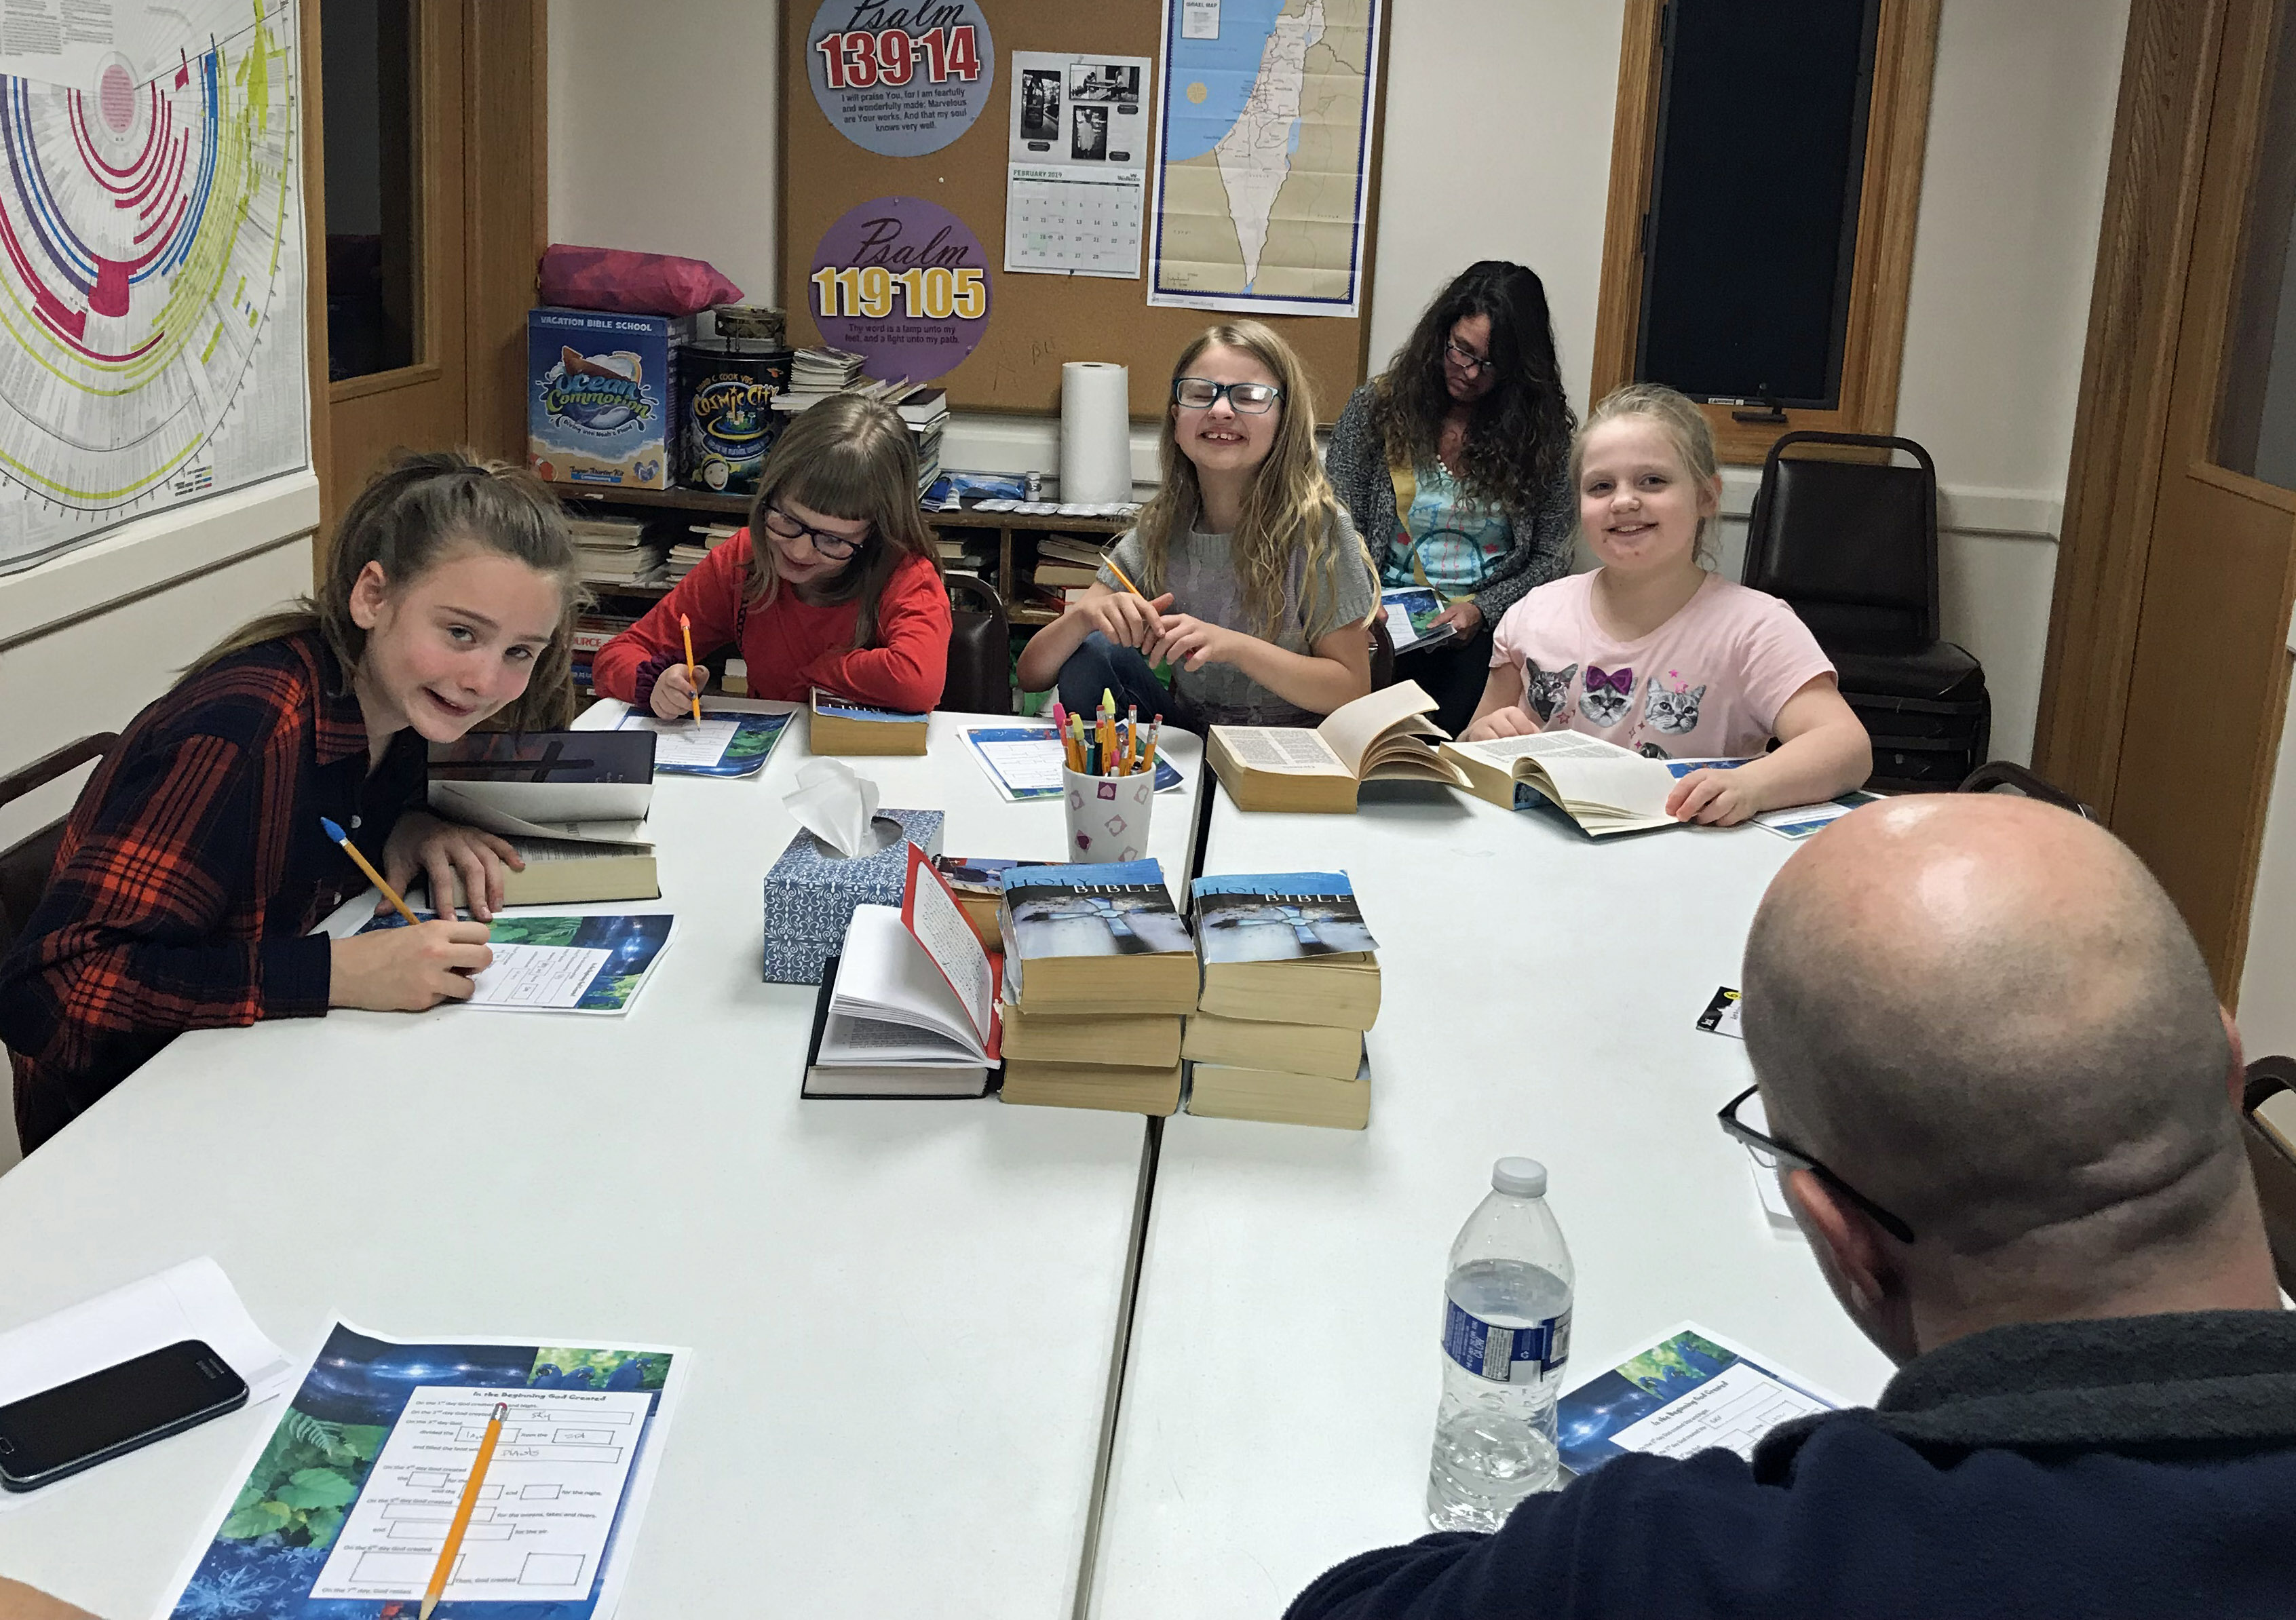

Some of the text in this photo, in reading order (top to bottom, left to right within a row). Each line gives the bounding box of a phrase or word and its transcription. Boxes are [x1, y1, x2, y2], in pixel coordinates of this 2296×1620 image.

[846, 0, 964, 30] Psalm
[816, 25, 980, 89] 139:14
[846, 94, 859, 102] will
[861, 93, 883, 102] praise
[885, 92, 902, 101] You,
[904, 91, 915, 99] for
[934, 88, 965, 98] fearfully
[842, 104, 856, 113] and
[858, 102, 902, 112] wonderfully
[927, 99, 967, 108] Marvelous
[857, 114, 875, 123] Your
[904, 112, 919, 120] And
[921, 111, 936, 119] that
[937, 111, 948, 120] my
[951, 109, 967, 117] soul
[875, 123, 900, 132] knows
[901, 124, 917, 132] very
[1013, 170, 1046, 178] FEBRUARY
[852, 218, 969, 265] Psalm
[811, 266, 986, 319] 119:105
[541, 316, 653, 332] VACATION BIBLE SCHOOL
[849, 324, 864, 334] Thy
[902, 325, 922, 334] lamp
[944, 327, 956, 335] my
[864, 334, 879, 343] and
[887, 334, 905, 345] light
[926, 336, 938, 345] my
[940, 335, 959, 345] path.
[719, 373, 738, 381] COOK
[556, 372, 640, 400] Ocean
[546, 389, 651, 420] Commotion
[692, 387, 746, 417] COSMIC
[563, 419, 581, 433] Diving
[582, 429, 595, 437] into
[574, 637, 602, 647] URCE
[1010, 877, 1090, 888] HOLY
[1073, 883, 1160, 894] BIBLE
[1203, 887, 1282, 895] HOLY
[1264, 893, 1351, 903] BIBLE
[1666, 1399, 1698, 1416] Beginning
[1693, 1393, 1708, 1401] God
[1704, 1381, 1729, 1395] Created
